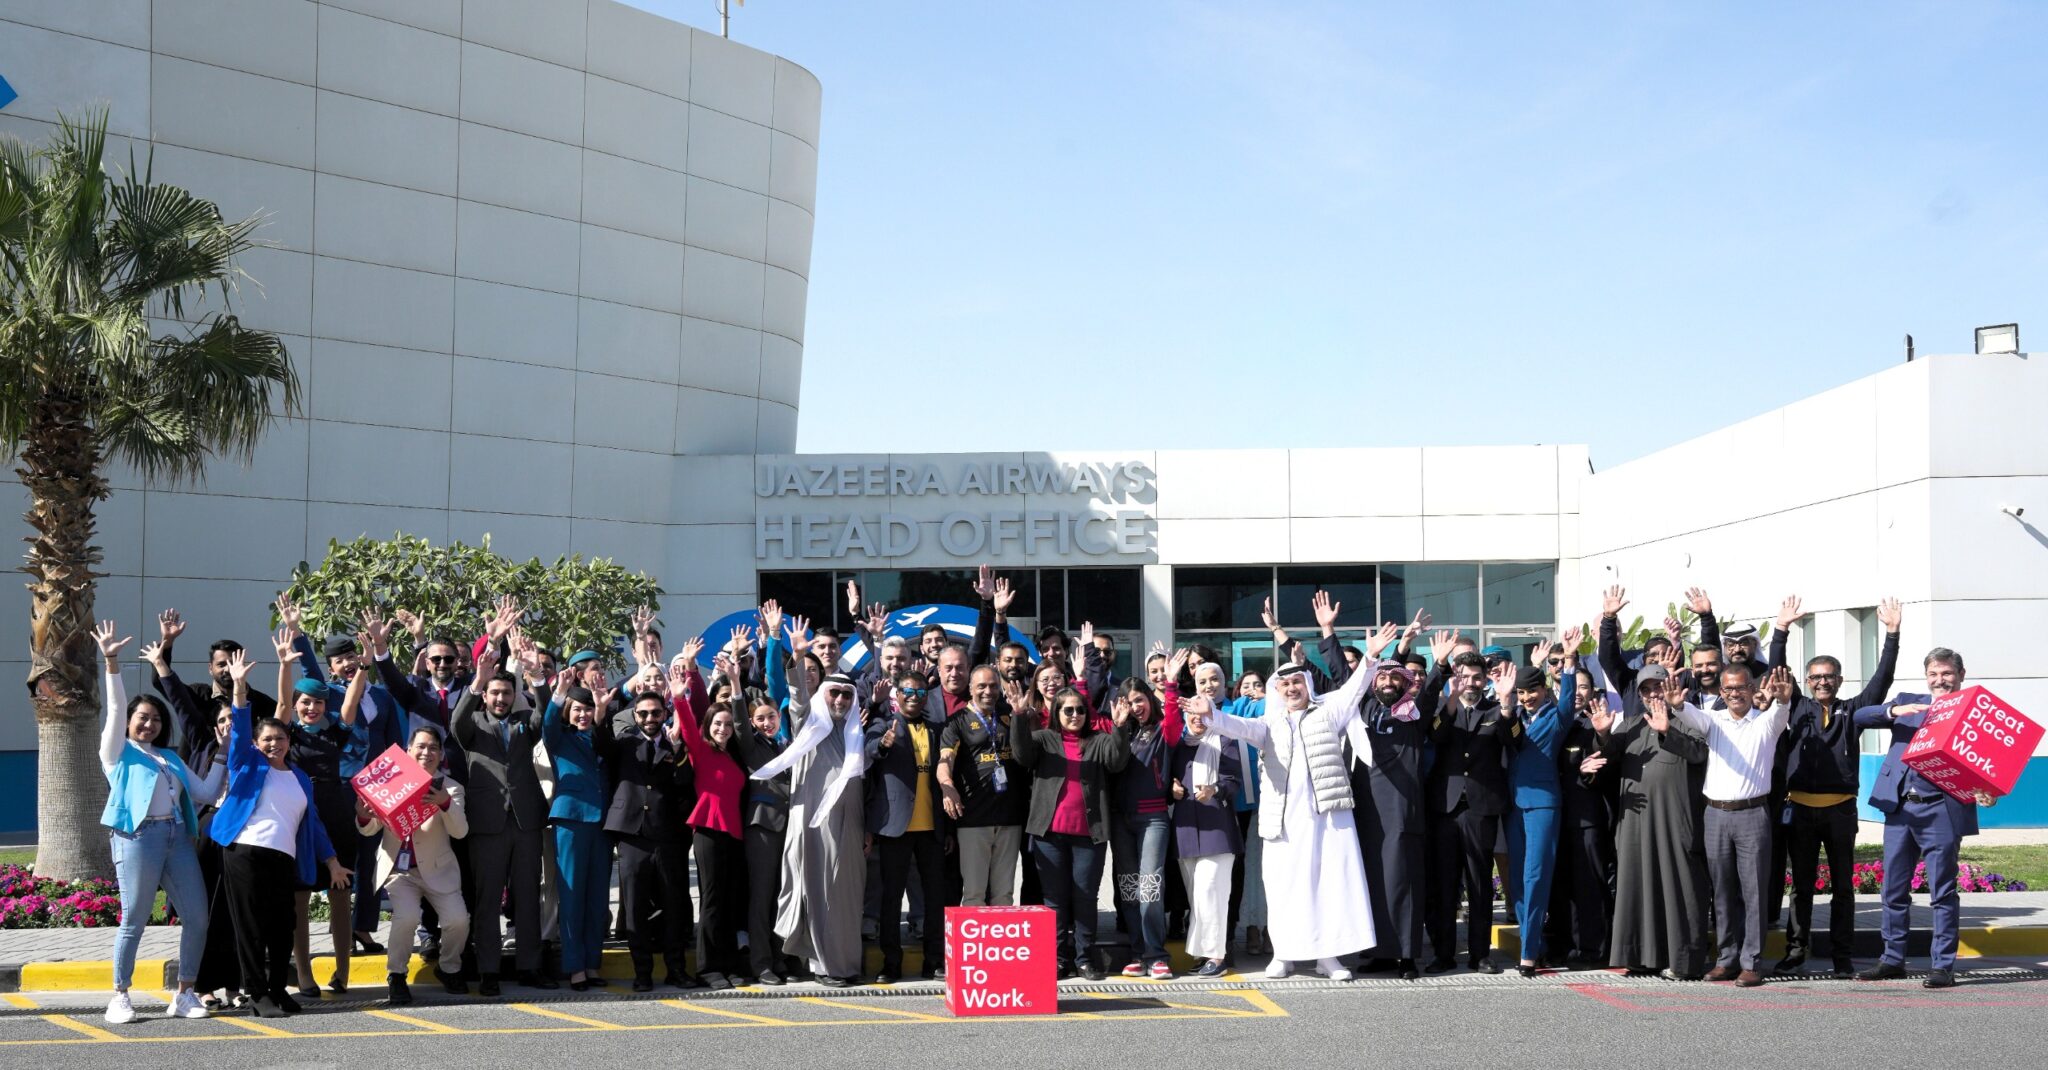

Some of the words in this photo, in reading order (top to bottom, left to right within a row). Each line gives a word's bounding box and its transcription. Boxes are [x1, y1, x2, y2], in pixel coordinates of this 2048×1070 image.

[755, 461, 946, 497] JAZEERA
[959, 460, 1146, 495] AIRWAYS
[755, 513, 920, 558] HEAD
[940, 510, 1147, 557] OFFICE
[1931, 694, 1964, 712] Great
[1976, 693, 2025, 734] Great
[1916, 727, 1928, 740] To
[1961, 720, 1978, 742] To
[1968, 707, 2015, 747] Place
[356, 756, 393, 786] Great
[1909, 756, 1947, 770] Great
[1923, 767, 1960, 780] Place
[364, 764, 400, 793] Place
[1936, 780, 1957, 790] To
[372, 788, 389, 800] To
[396, 812, 412, 836] Great
[407, 804, 422, 828] Place
[960, 919, 1031, 939] Great
[962, 942, 1031, 961] Place
[960, 965, 988, 985] To
